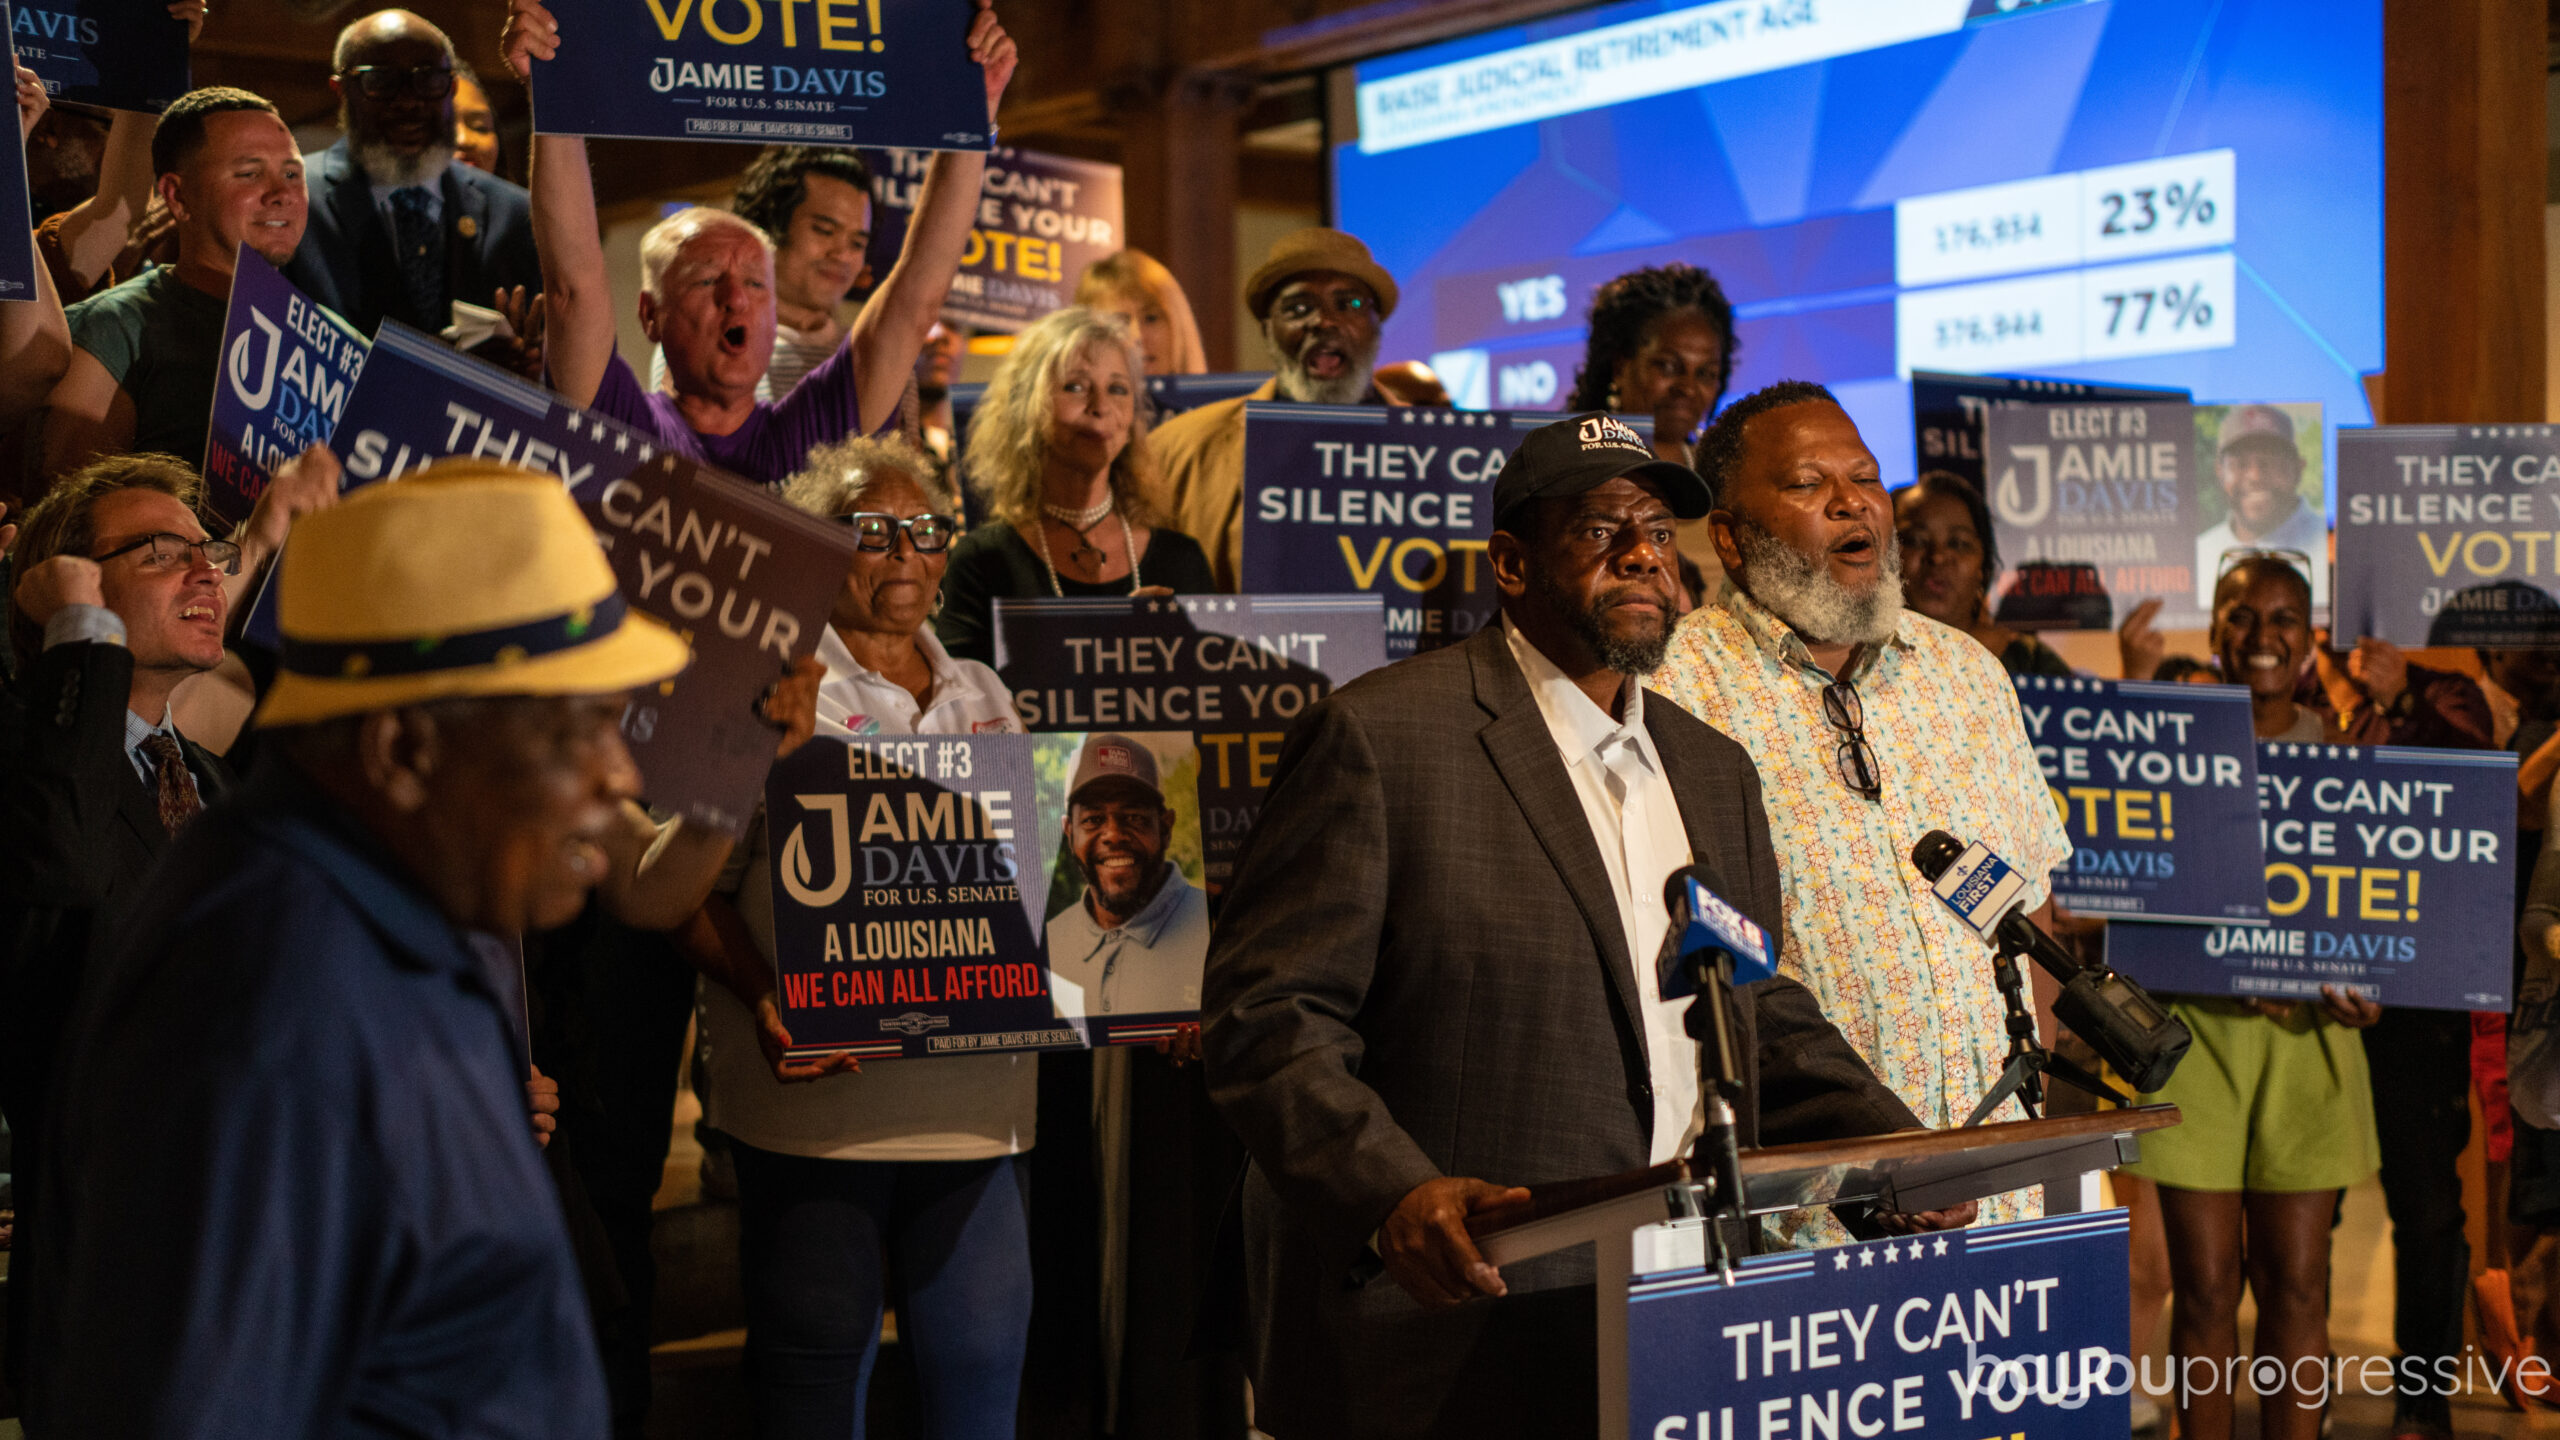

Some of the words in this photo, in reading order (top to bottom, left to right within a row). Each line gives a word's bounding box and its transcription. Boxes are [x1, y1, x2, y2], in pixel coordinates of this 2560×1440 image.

[12, 6, 99, 45] AVIS
[645, 0, 885, 53] VOTE!
[649, 57, 764, 93] JAMIE
[771, 65, 887, 98] DAVIS
[706, 95, 737, 109] FOR
[742, 97, 771, 110] U.S.
[775, 99, 836, 112] SENATE
[983, 167, 1079, 208] CAN'T
[2101, 179, 2216, 237] 23%
[1013, 205, 1113, 246] YOUR
[960, 230, 1063, 283] OTE!
[1498, 275, 1567, 323] YES
[2102, 282, 2214, 336] 77%
[287, 294, 340, 361] ELECT
[339, 344, 364, 380] #3
[229, 304, 345, 424] JAM
[1500, 361, 1557, 408] NO
[240, 423, 253, 460] A
[273, 416, 296, 446] FOR
[2051, 407, 2114, 439] ELECT
[212, 440, 238, 486] WE
[1314, 442, 1438, 482] THEY
[1581, 442, 1604, 452] FOR
[446, 400, 595, 494] THEY
[601, 478, 772, 582] CAN'T
[1997, 442, 2178, 527] JAMIE
[2396, 456, 2501, 486] THEY
[1258, 486, 1474, 529] SILENCE
[2058, 480, 2179, 514] DAVIS
[2350, 494, 2533, 525] SILENCE
[1337, 535, 1490, 594] VOT
[2418, 531, 2560, 577] VOT
[639, 549, 800, 662] YOUR
[1387, 608, 1443, 634] MIE
[1064, 637, 1184, 675] THEY
[1195, 633, 1327, 672] CAN'T
[1015, 684, 1223, 725] SILENCE
[2063, 706, 2194, 745] CAN'T
[848, 741, 929, 780] ELECT
[937, 741, 973, 779] #3
[2107, 750, 2242, 787] YOUR
[2050, 787, 2175, 841] TE!
[2313, 777, 2454, 817] CAN'T
[781, 790, 1014, 908] JAMIE
[2076, 847, 2175, 878] DAVIS
[2355, 823, 2500, 863] YOUR
[861, 843, 1019, 887] DAVIS
[1951, 857, 1999, 906] LOUISIANA
[863, 889, 901, 906] FOR
[907, 888, 942, 904] U.S.
[948, 885, 1019, 904] SENATE
[1958, 872, 1996, 913] FIRST
[2264, 862, 2420, 922] OTE!
[824, 922, 844, 963] A
[849, 917, 996, 961] LOUISIANA
[2204, 926, 2305, 957] JAMIE
[2313, 930, 2417, 962] DAVIS
[784, 972, 825, 1009] WE
[832, 968, 884, 1007] CAN
[892, 965, 939, 1004] ALL
[945, 962, 1048, 1000] AFFORD.
[934, 1038, 950, 1050] PAID
[952, 1037, 967, 1049] FOR
[968, 1036, 978, 1048] BY
[980, 1035, 1000, 1047] JAMIE
[1002, 1033, 1024, 1046] DAVIS
[1025, 1033, 1039, 1045] FOR
[1040, 1032, 1050, 1044] US
[1051, 1030, 1079, 1043] SENATE
[1723, 1304, 1879, 1381] THEY
[1894, 1277, 2059, 1354] CAN'T
[1947, 1346, 2111, 1421] YOUR
